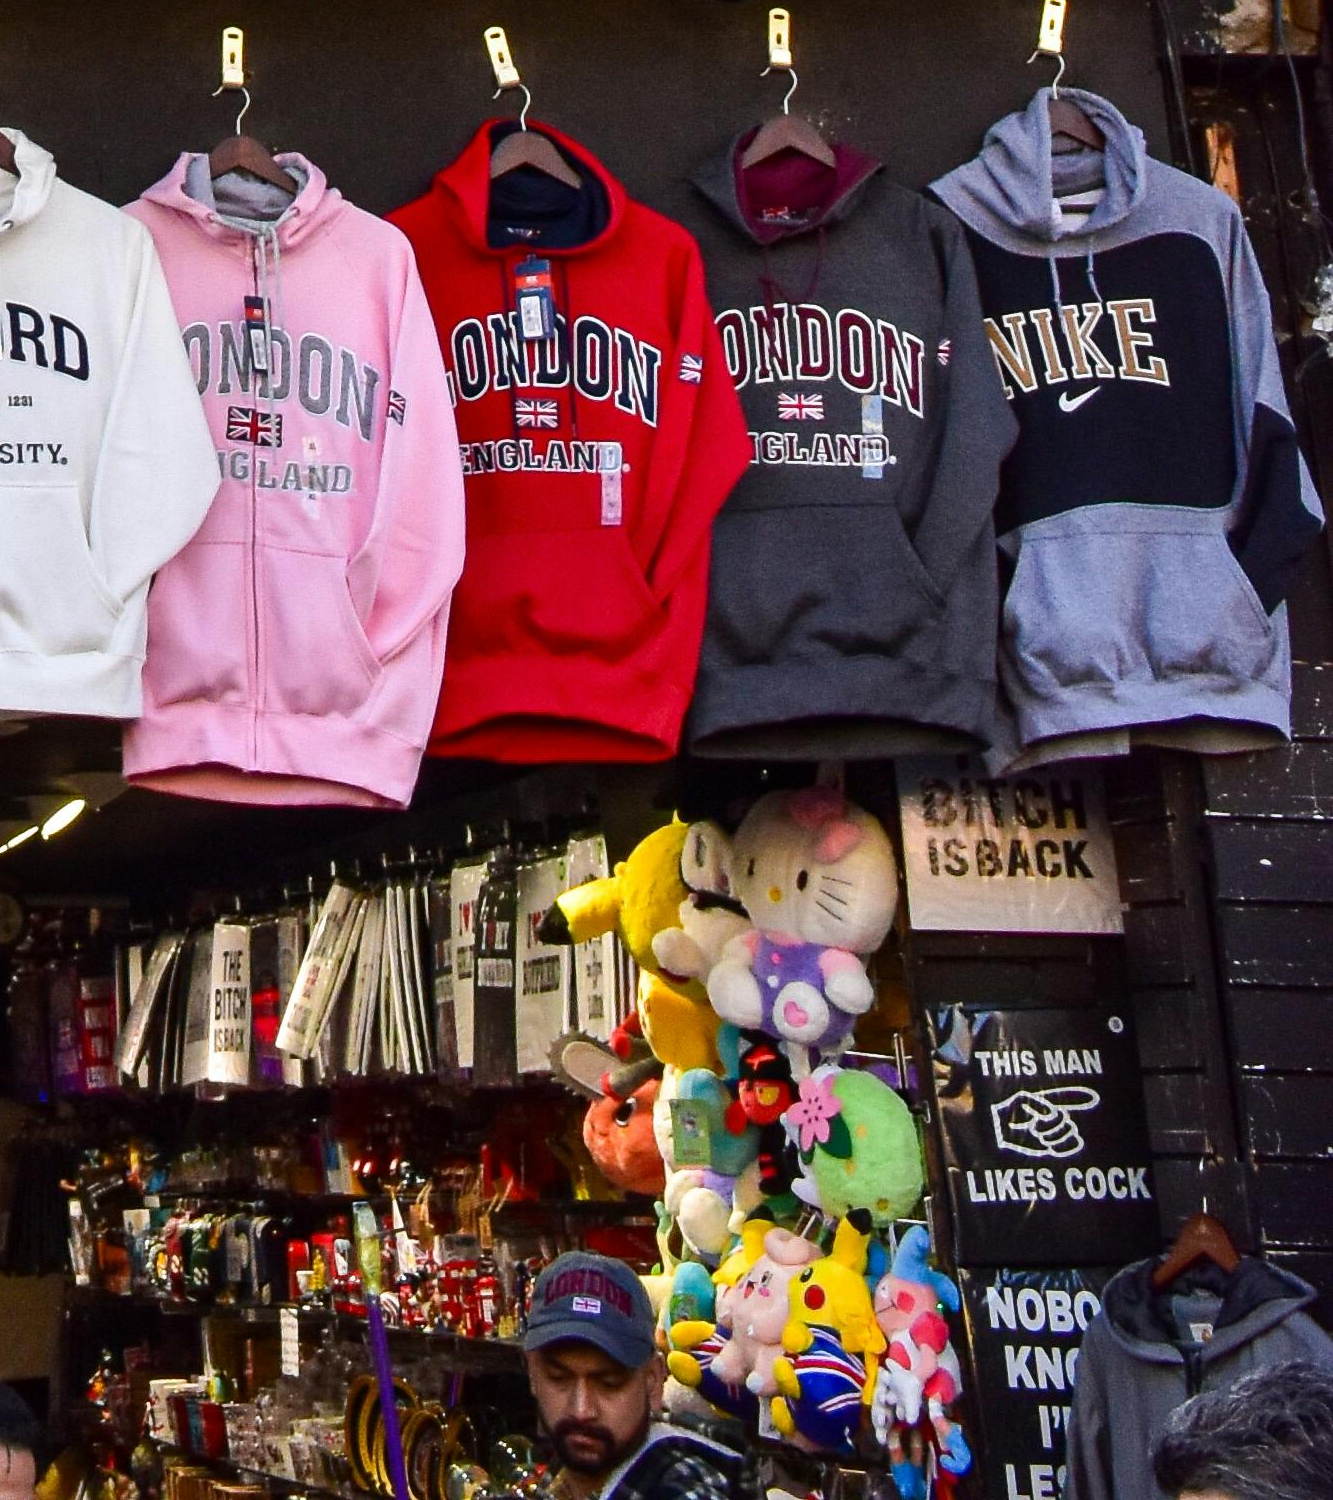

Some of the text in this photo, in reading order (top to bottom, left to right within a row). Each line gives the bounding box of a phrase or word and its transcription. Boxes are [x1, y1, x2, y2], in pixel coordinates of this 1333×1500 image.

[445, 311, 662, 427] ONDON
[715, 303, 925, 418] ONDON
[983, 298, 1171, 401] NIKE
[182, 320, 380, 443] ONDON
[223, 950, 243, 982] THE
[215, 988, 248, 1020] BITCH
[975, 1049, 1103, 1076] THIS MAN
[966, 1166, 1152, 1202] LIKES COCK
[986, 1286, 1102, 1333] NOBO
